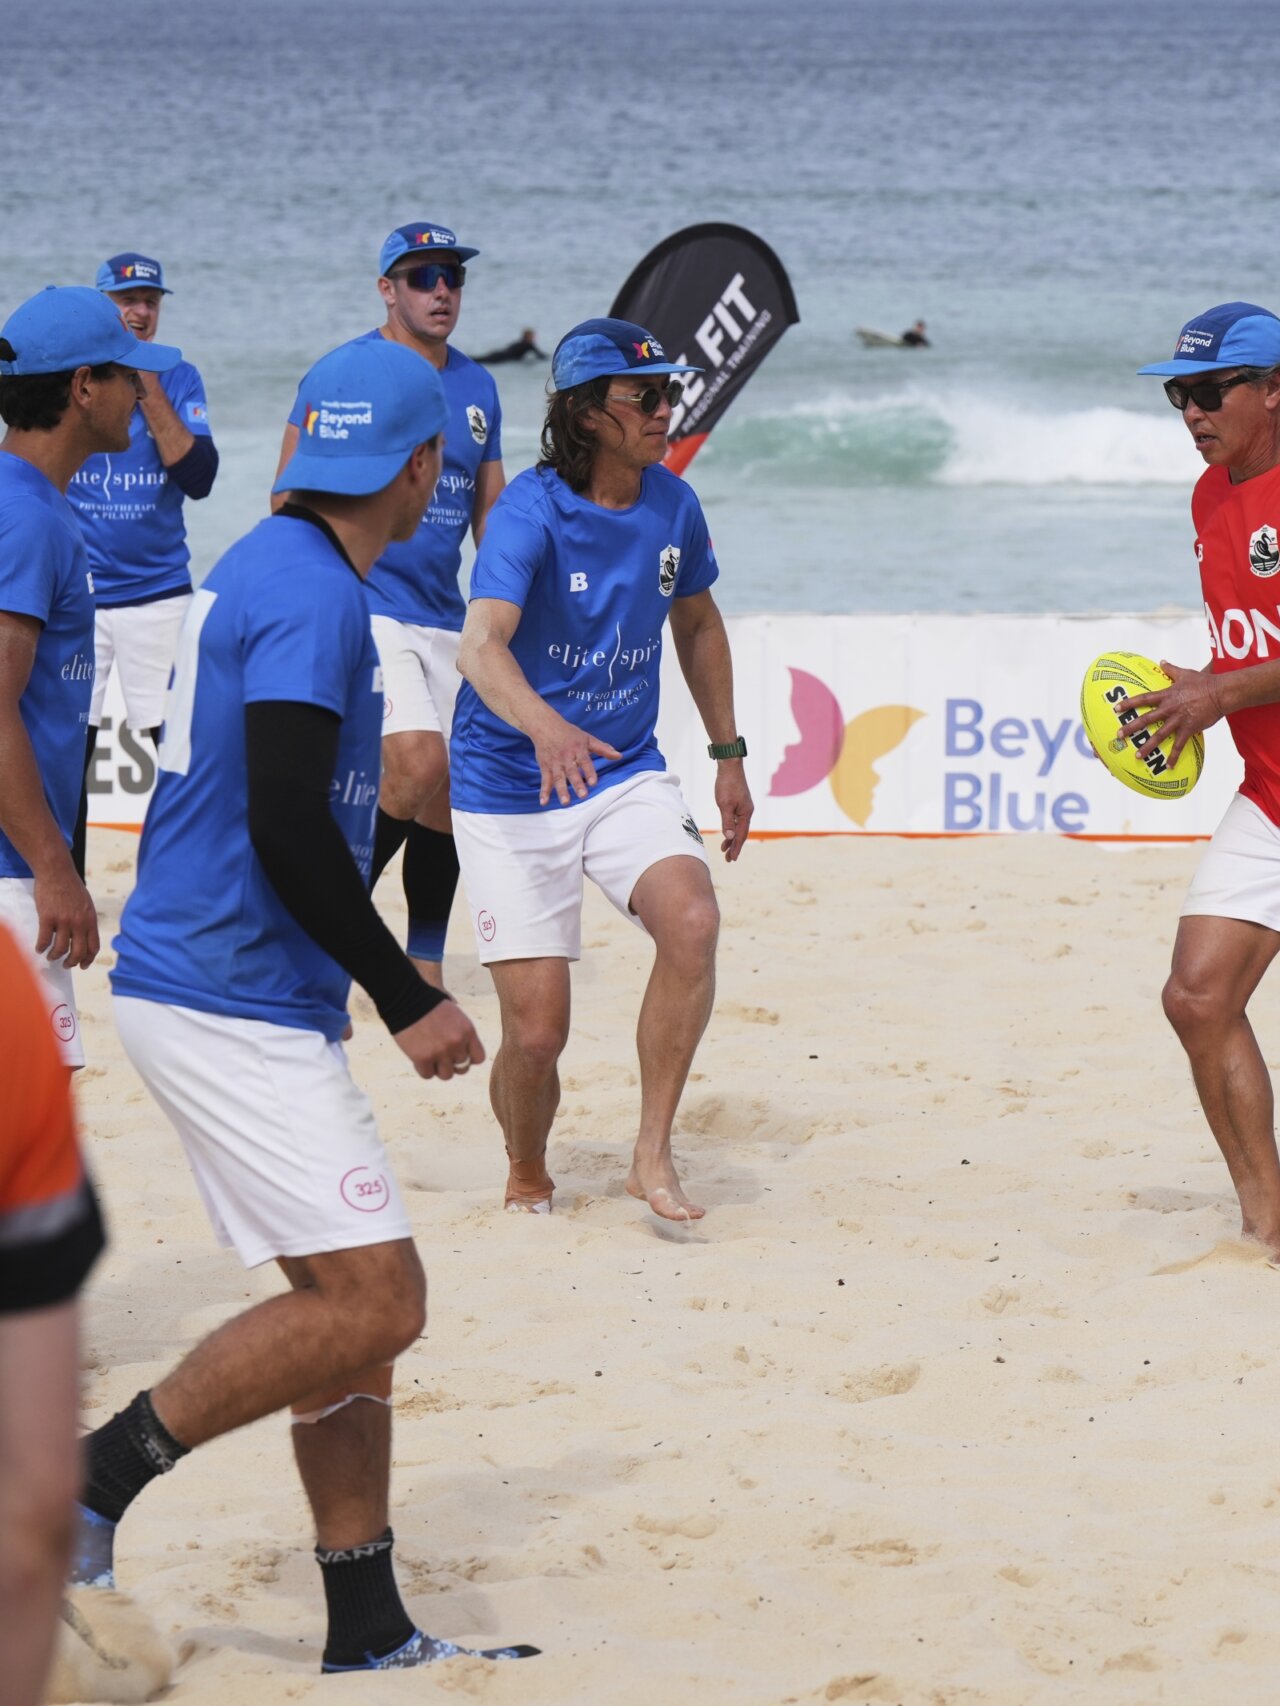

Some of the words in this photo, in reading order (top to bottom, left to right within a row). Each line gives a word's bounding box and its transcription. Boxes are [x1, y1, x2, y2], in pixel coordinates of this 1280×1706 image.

[694, 272, 757, 368] FIT
[727, 309, 772, 369] TRAINING
[1180, 343, 1195, 353] Blue
[1184, 334, 1212, 347] Beyond
[321, 409, 371, 428] Beyond
[319, 424, 349, 438] Blue
[80, 502, 156, 512] PHYSIOTHERAPY
[102, 512, 143, 520] PILATES
[570, 572, 588, 592] B
[548, 644, 606, 667] elite
[61, 653, 93, 680] elite
[944, 773, 1090, 832] Blue
[59, 1016, 72, 1028] 325
[355, 1180, 382, 1197] 325
